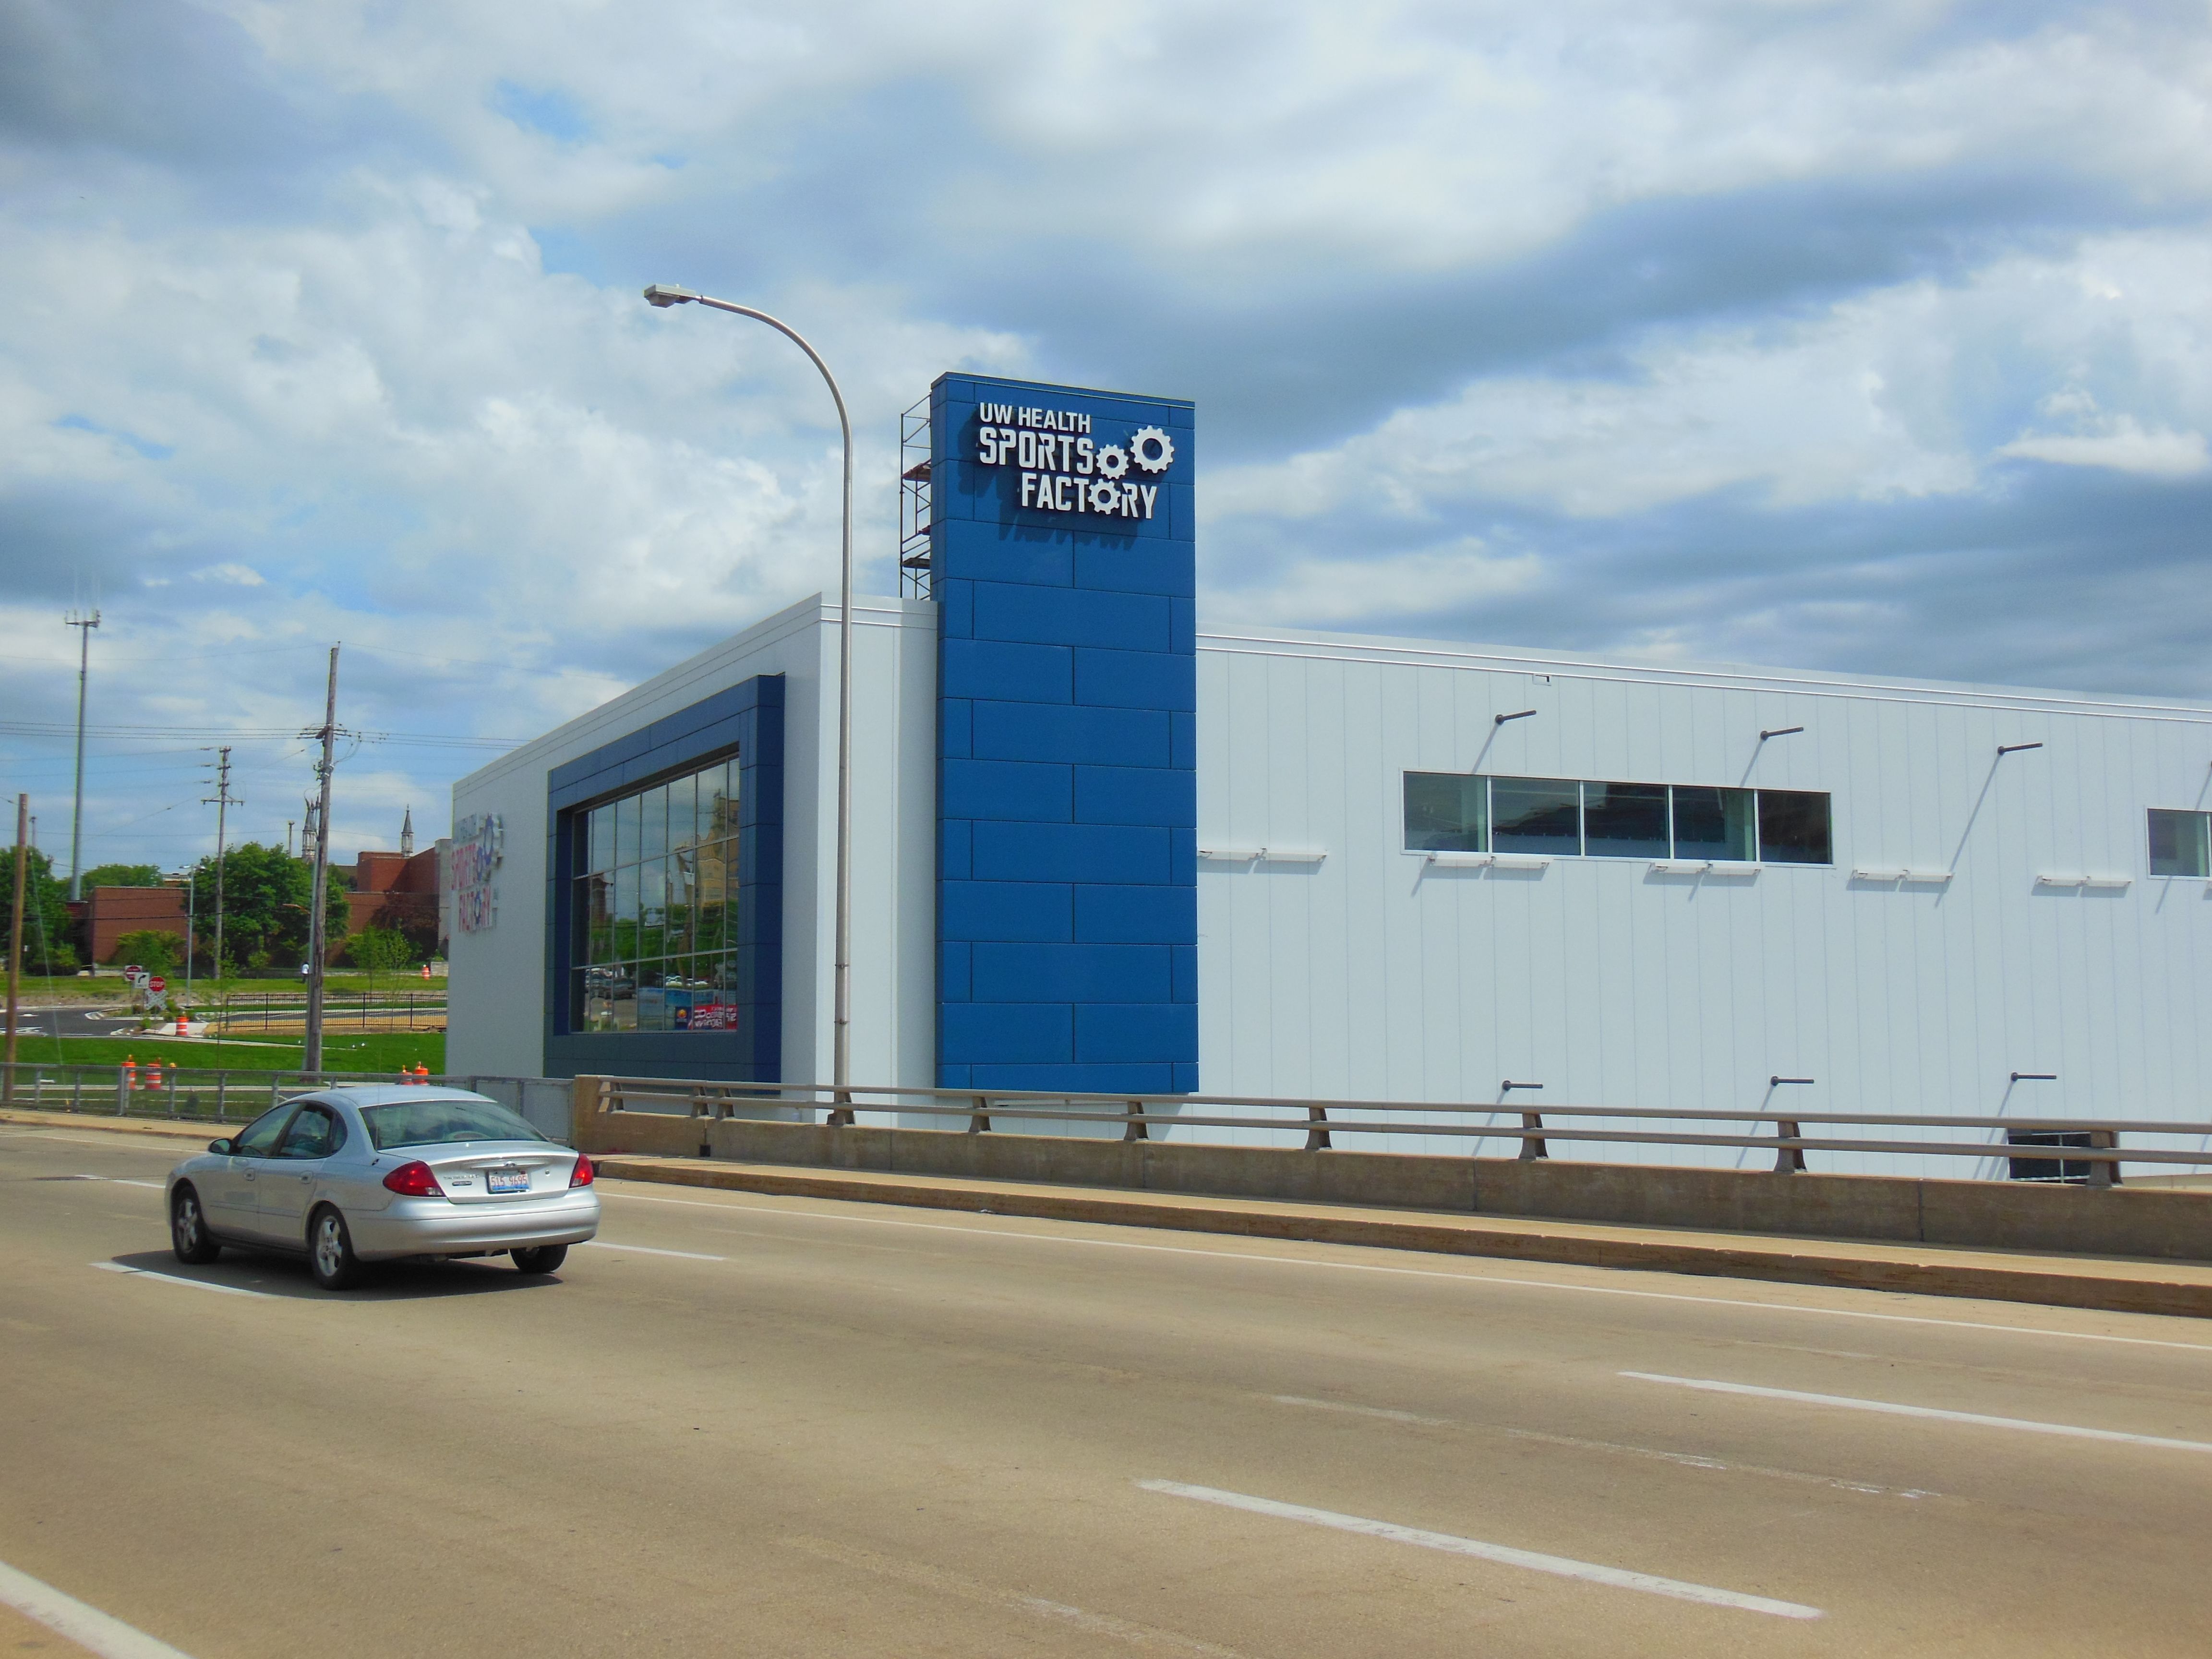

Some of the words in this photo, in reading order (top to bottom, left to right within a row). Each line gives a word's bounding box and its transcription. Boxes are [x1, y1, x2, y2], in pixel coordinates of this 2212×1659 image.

[980, 402, 1012, 424] UW
[1018, 406, 1091, 433] HEALTH
[980, 427, 1094, 474] SPORTS
[1022, 471, 1157, 519] FACTORY
